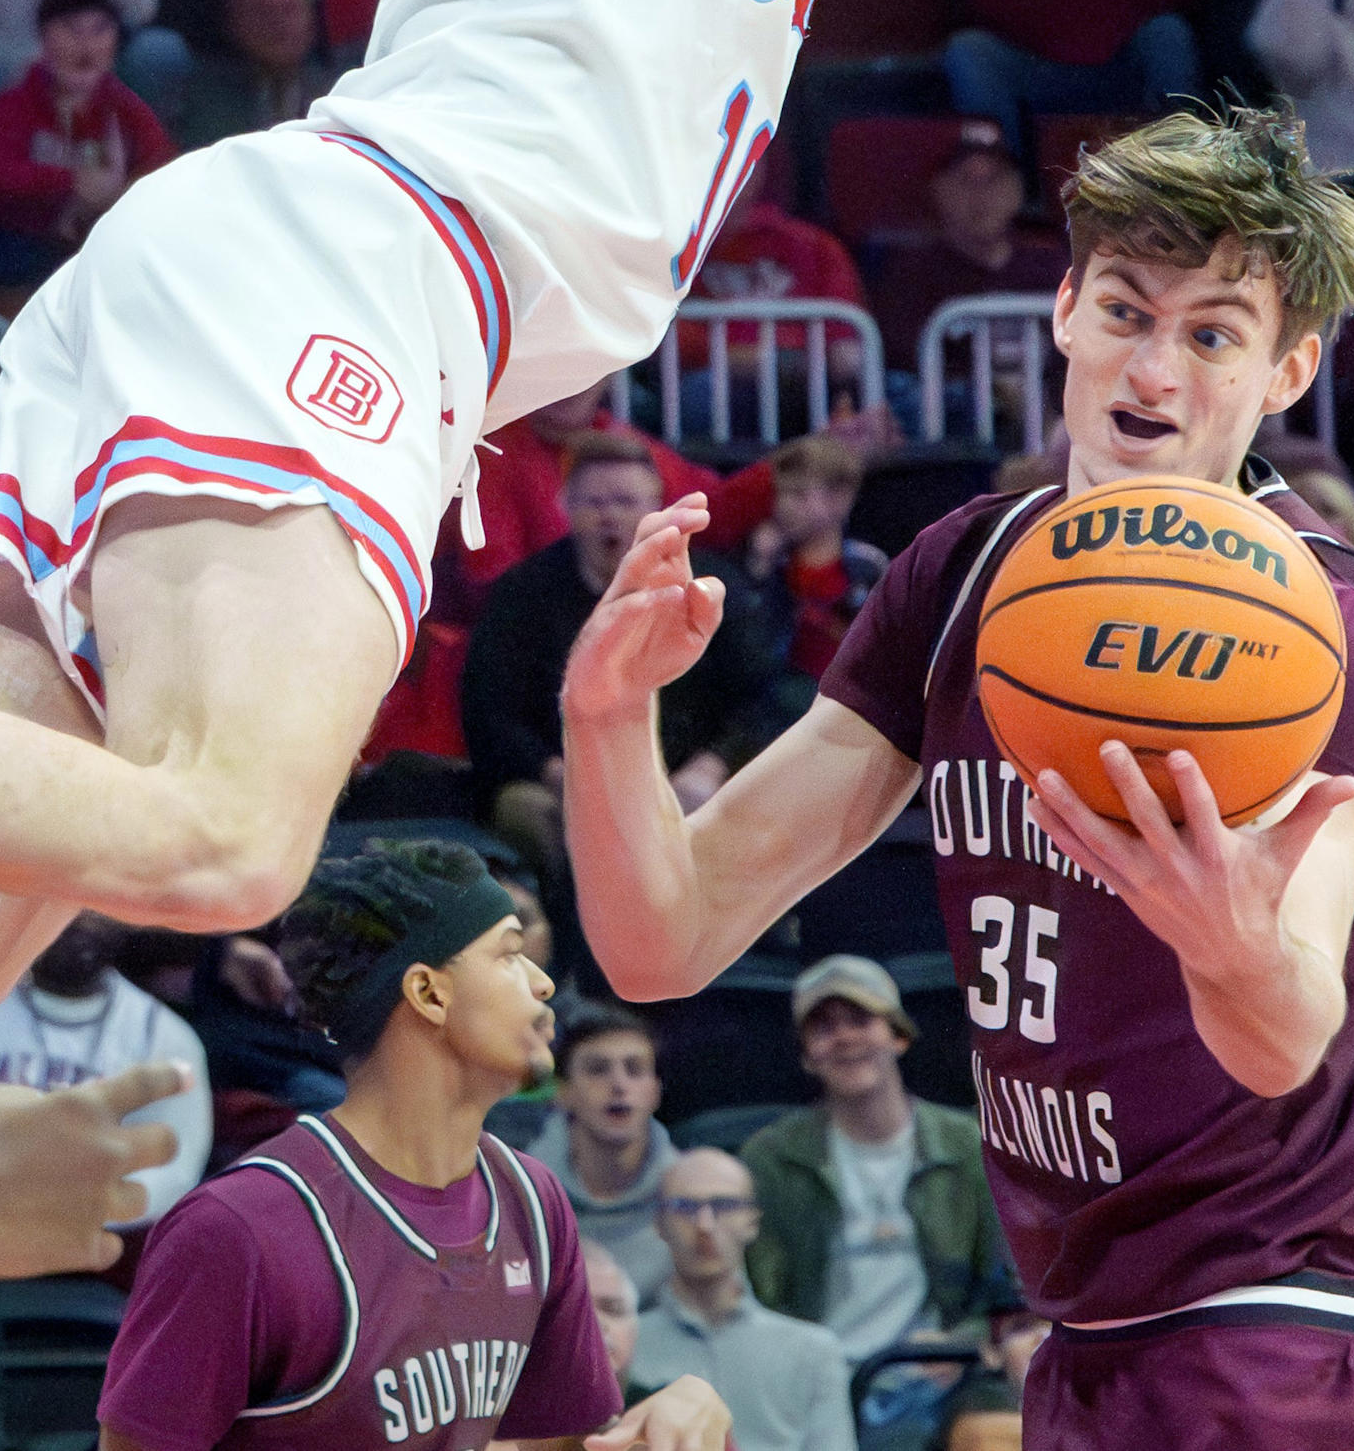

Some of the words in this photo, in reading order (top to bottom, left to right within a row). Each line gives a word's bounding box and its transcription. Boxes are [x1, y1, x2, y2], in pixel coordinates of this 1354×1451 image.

[307, 349, 383, 426] B
[1050, 504, 1288, 589] Wilson
[1084, 620, 1239, 682] EVO
[1238, 639, 1285, 661] NXT
[968, 895, 1059, 1044] 35
[971, 1049, 1123, 1184] ILLINOIS
